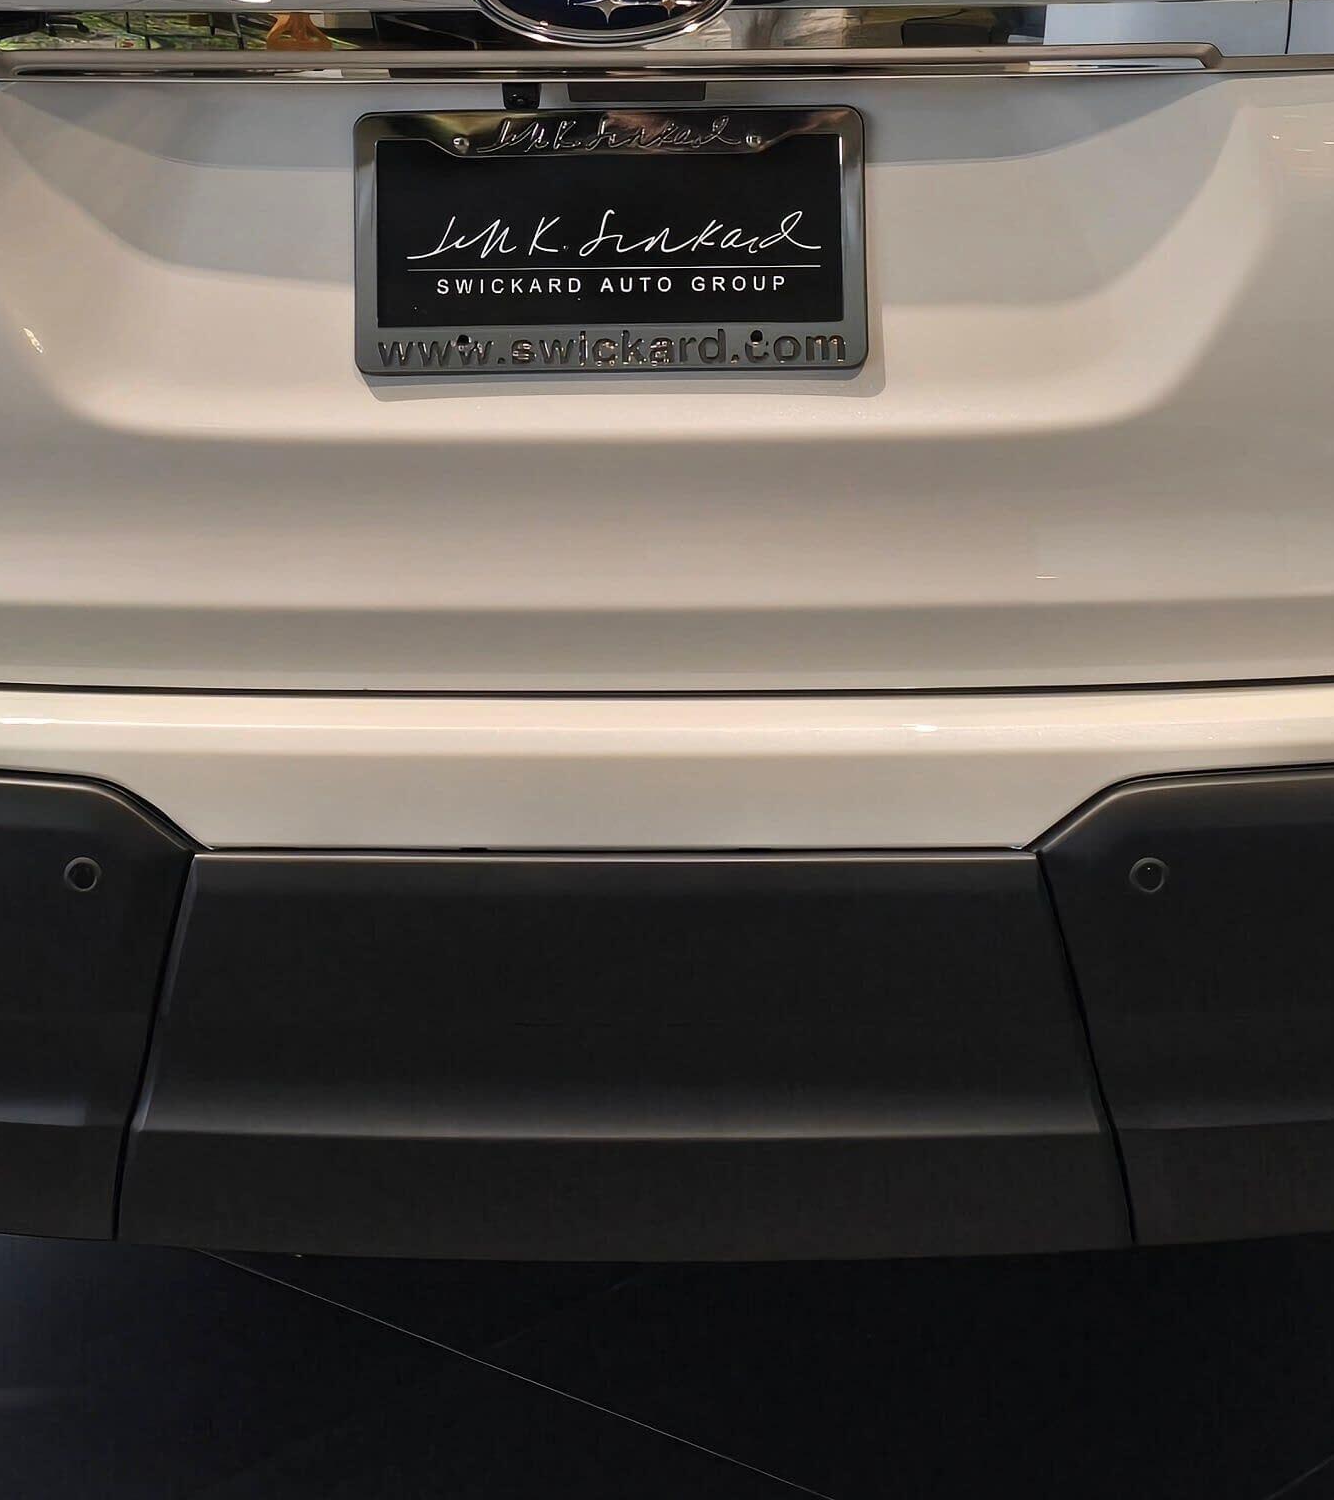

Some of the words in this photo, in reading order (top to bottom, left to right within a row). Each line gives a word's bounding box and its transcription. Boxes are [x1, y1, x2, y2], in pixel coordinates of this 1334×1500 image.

[436, 277, 582, 295] SWICKARD
[599, 276, 672, 293] AUTO
[690, 274, 787, 292] GROUP
[377, 329, 847, 368] www.swickard.com
